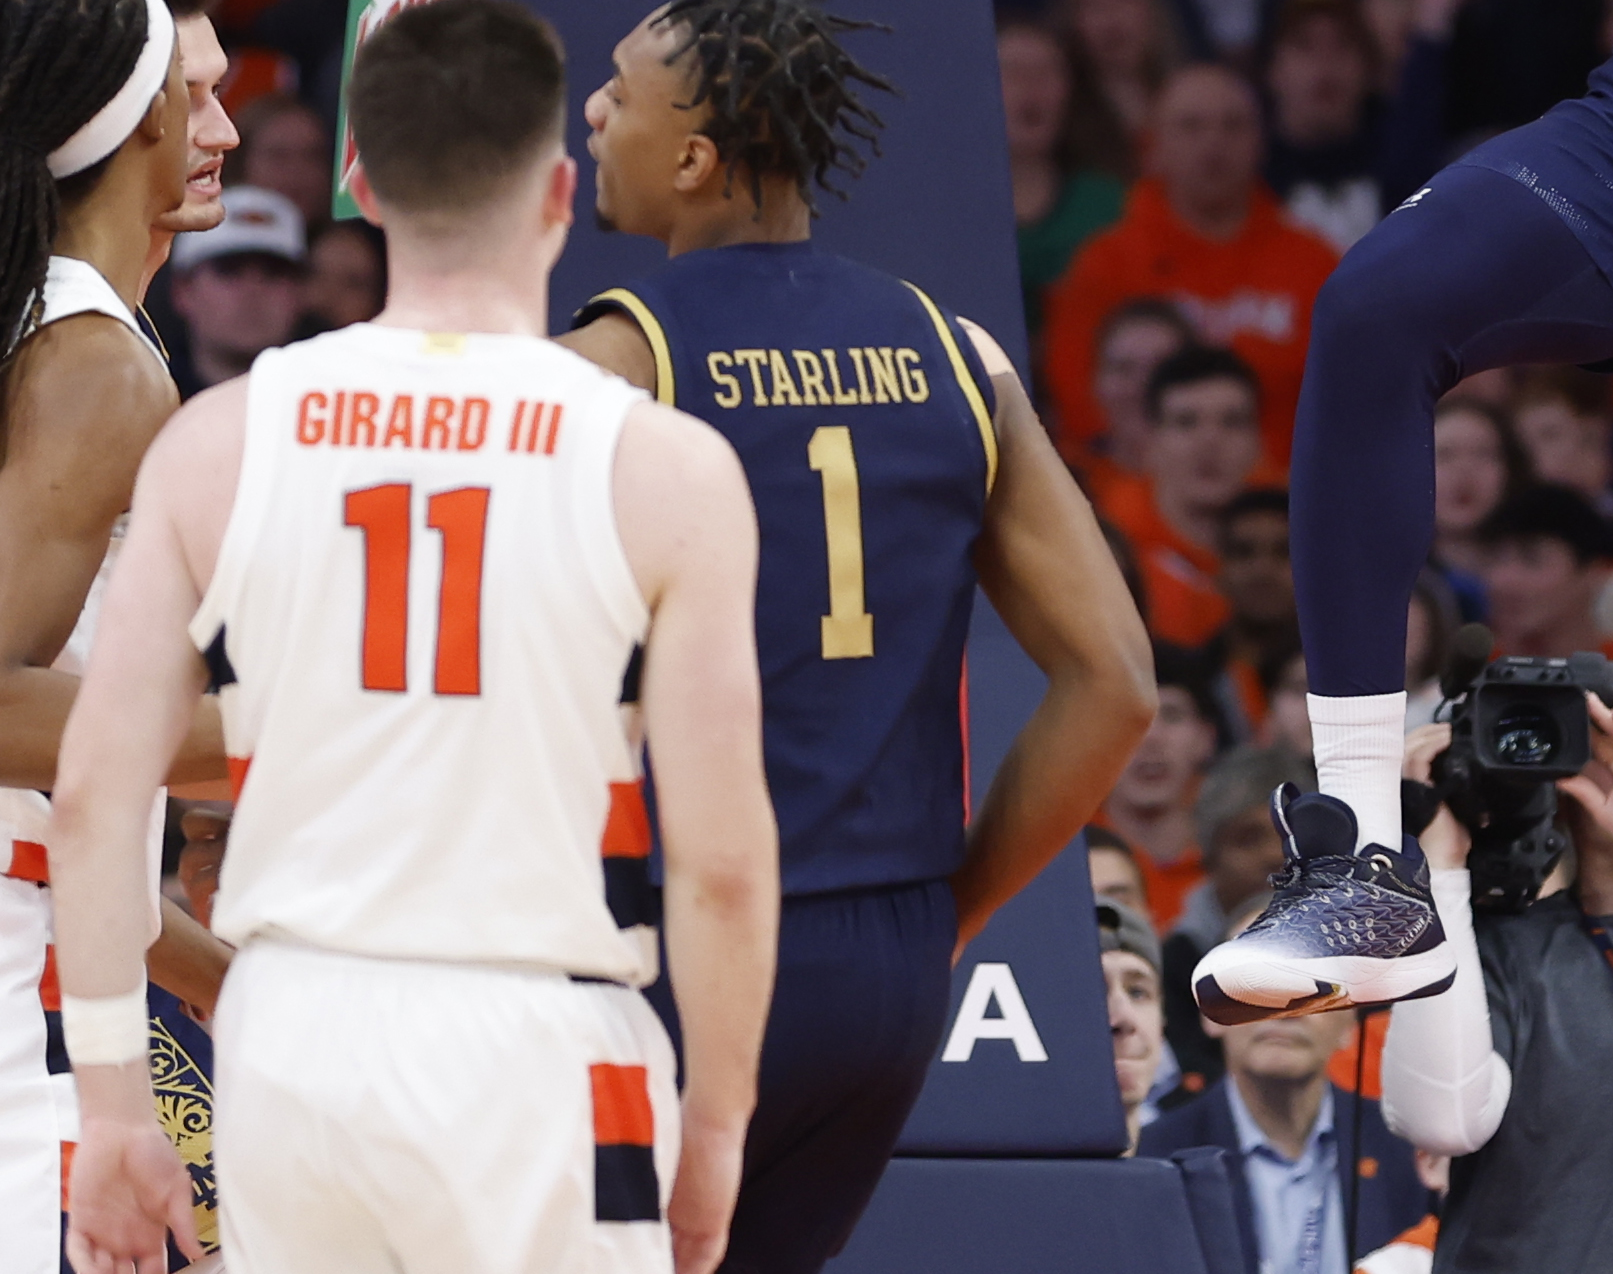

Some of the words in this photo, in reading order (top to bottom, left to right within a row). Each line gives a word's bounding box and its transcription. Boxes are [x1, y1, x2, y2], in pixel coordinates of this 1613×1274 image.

[296, 390, 491, 452] GIRARD
[508, 399, 563, 456] III
[706, 346, 931, 410] STARLING
[343, 482, 492, 697] 11
[806, 425, 876, 661] 1
[941, 962, 1050, 1062] A
